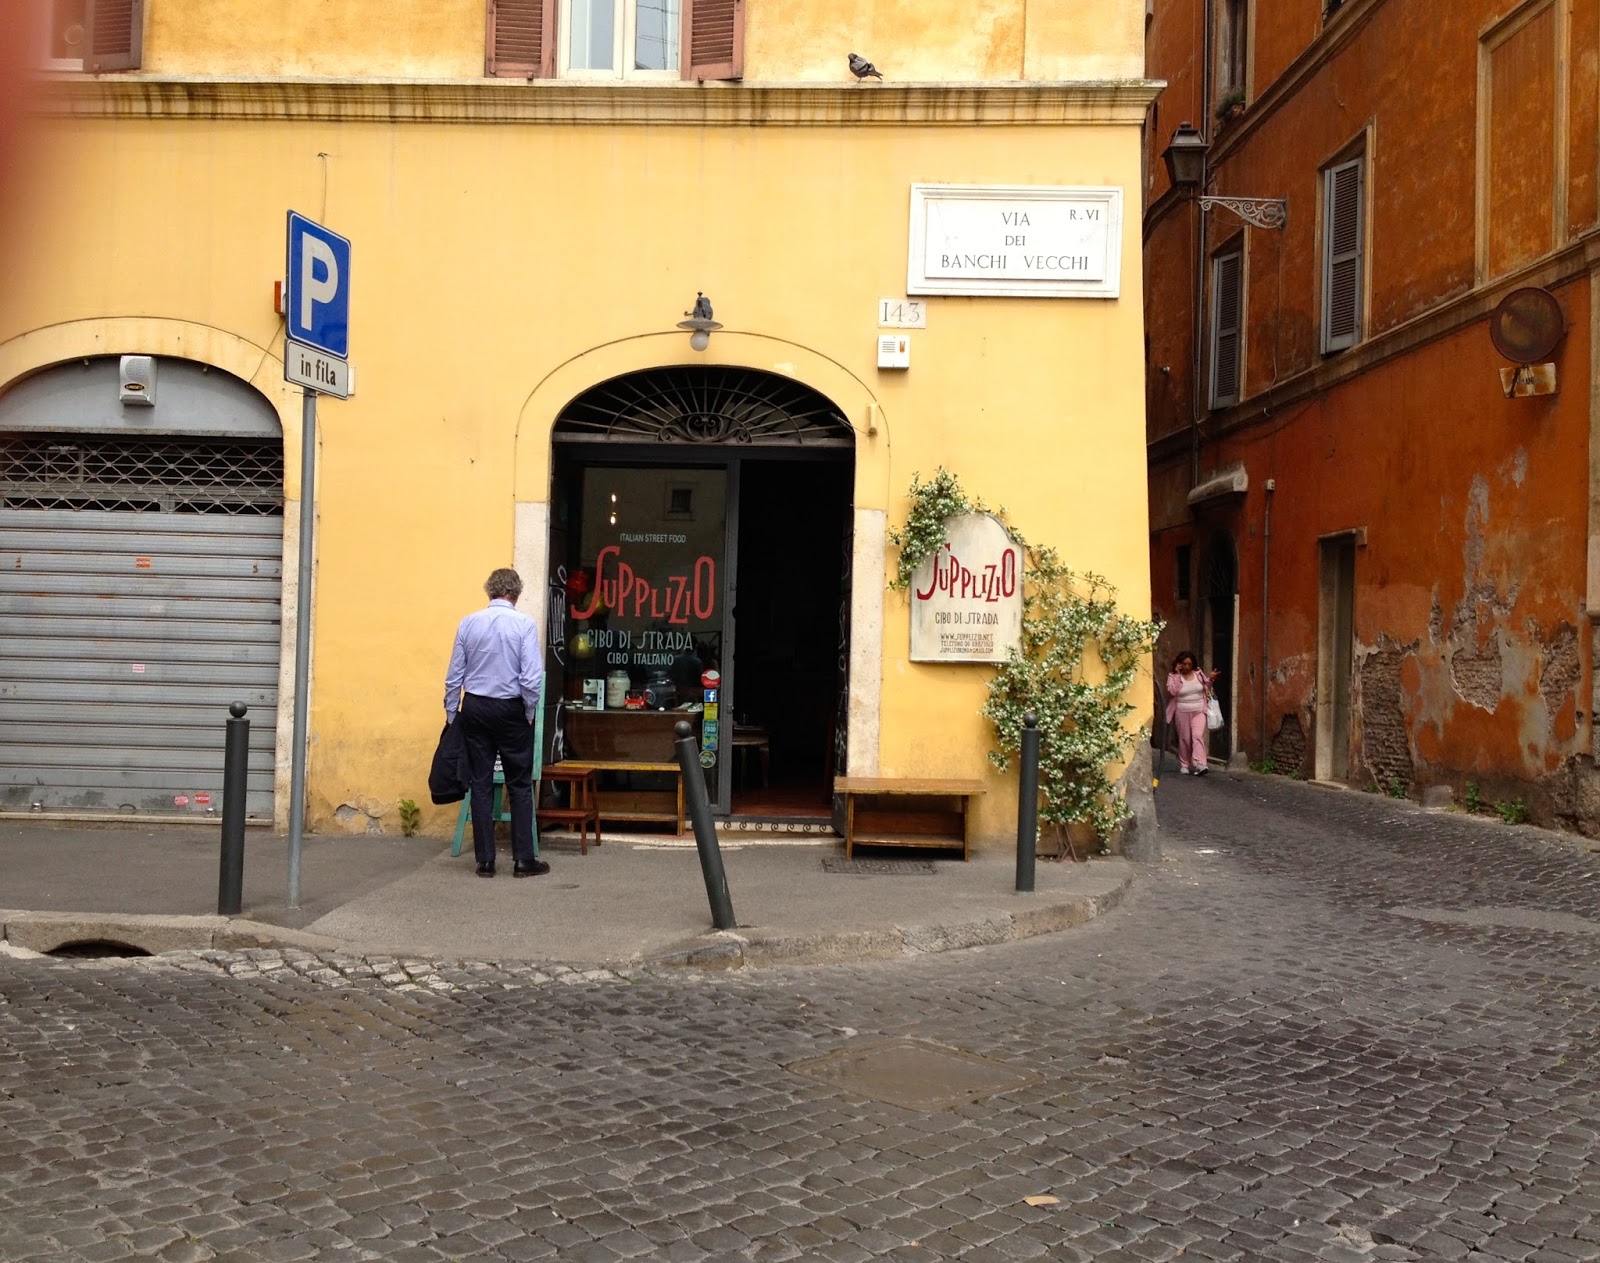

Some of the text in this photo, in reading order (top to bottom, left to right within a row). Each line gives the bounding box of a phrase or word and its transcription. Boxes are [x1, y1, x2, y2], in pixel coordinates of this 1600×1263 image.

[1002, 212, 1031, 226] VIA
[1005, 235, 1026, 246] DEI
[941, 254, 1088, 270] BANCHI VECCHI
[301, 231, 338, 331] P
[883, 302, 920, 322] 143
[301, 354, 336, 386] in fila
[619, 533, 687, 543] ITALIAN STREET FOOD
[570, 545, 715, 624] SUPPLIZIO
[935, 611, 999, 625] CIBO DI STRADA
[586, 629, 694, 651] CIBO DI STRADA
[607, 652, 675, 666] CIBO ITALIANO
